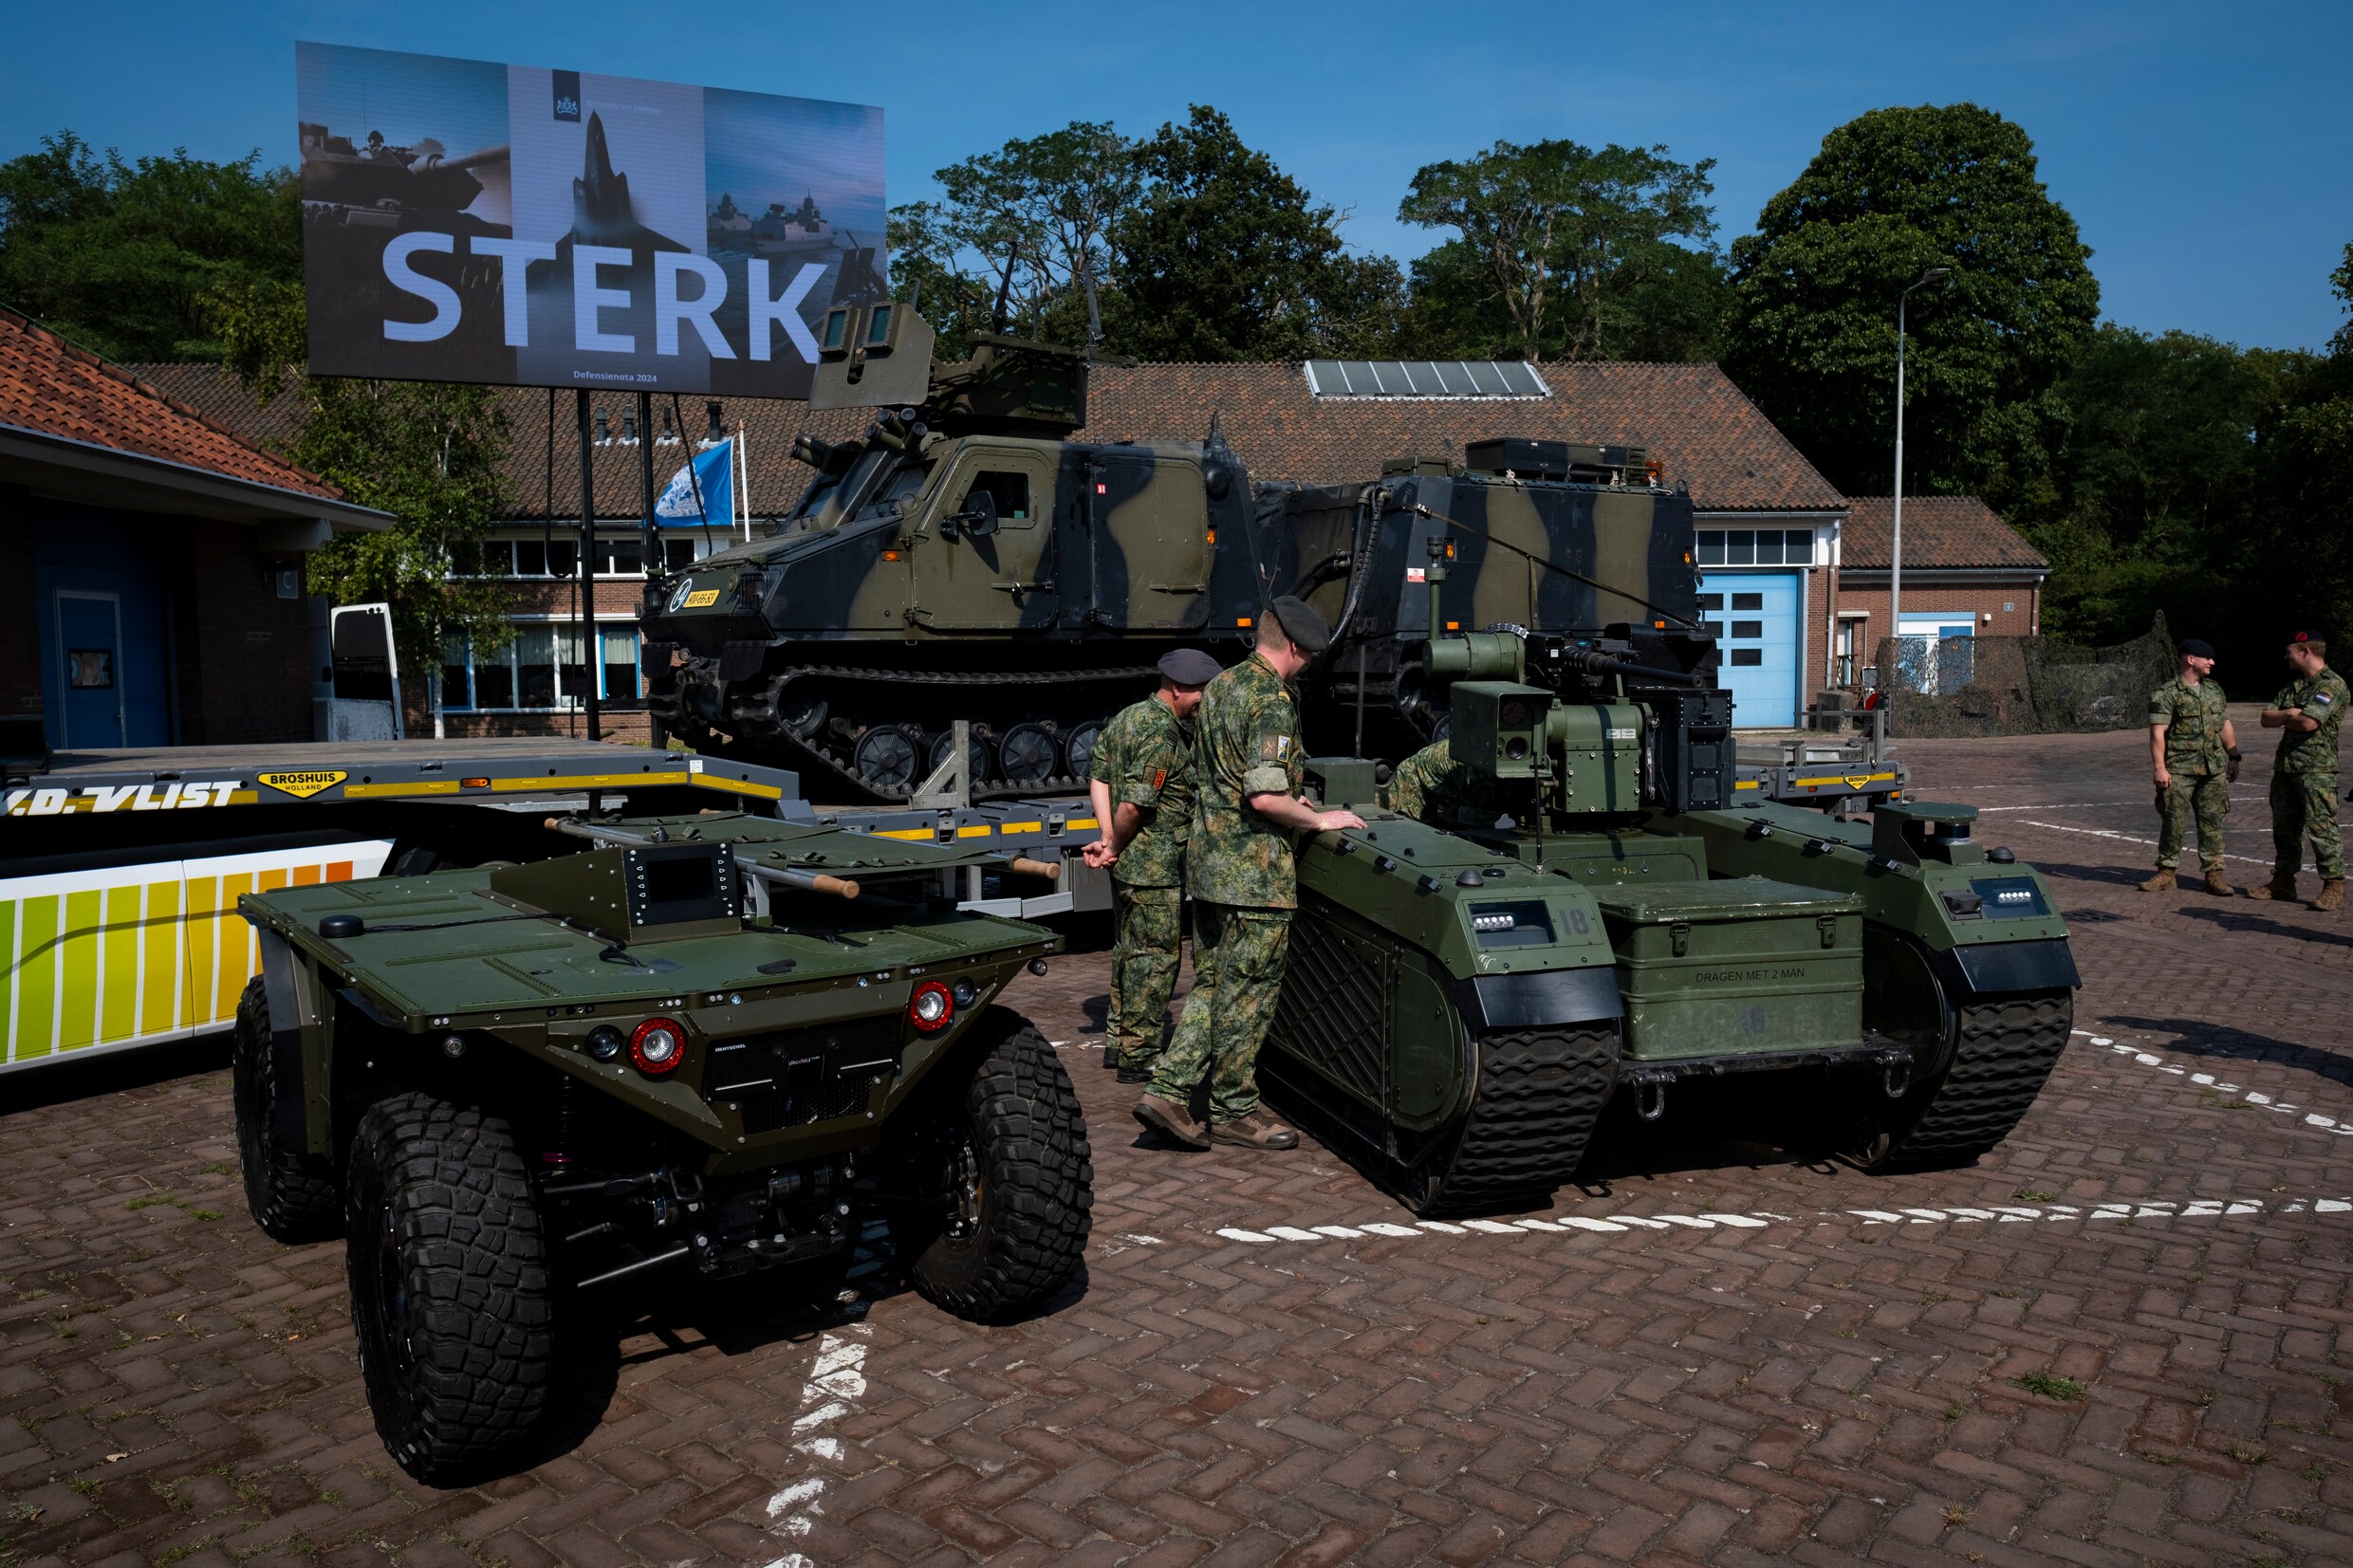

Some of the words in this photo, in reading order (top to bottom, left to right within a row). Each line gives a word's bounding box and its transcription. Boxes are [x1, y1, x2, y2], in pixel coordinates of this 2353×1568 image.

[382, 231, 828, 364] STERK
[573, 370, 635, 381] Defensienota
[636, 374, 658, 382] 2024
[283, 571, 292, 589] C
[269, 771, 336, 784] BROSHUIS
[82, 780, 245, 813] VLIST
[1558, 909, 1589, 935] 18
[1695, 971, 1743, 983] DRAGEN
[1746, 969, 1769, 981] MET
[1771, 969, 1778, 980] 2
[1781, 968, 1805, 979] MAN
